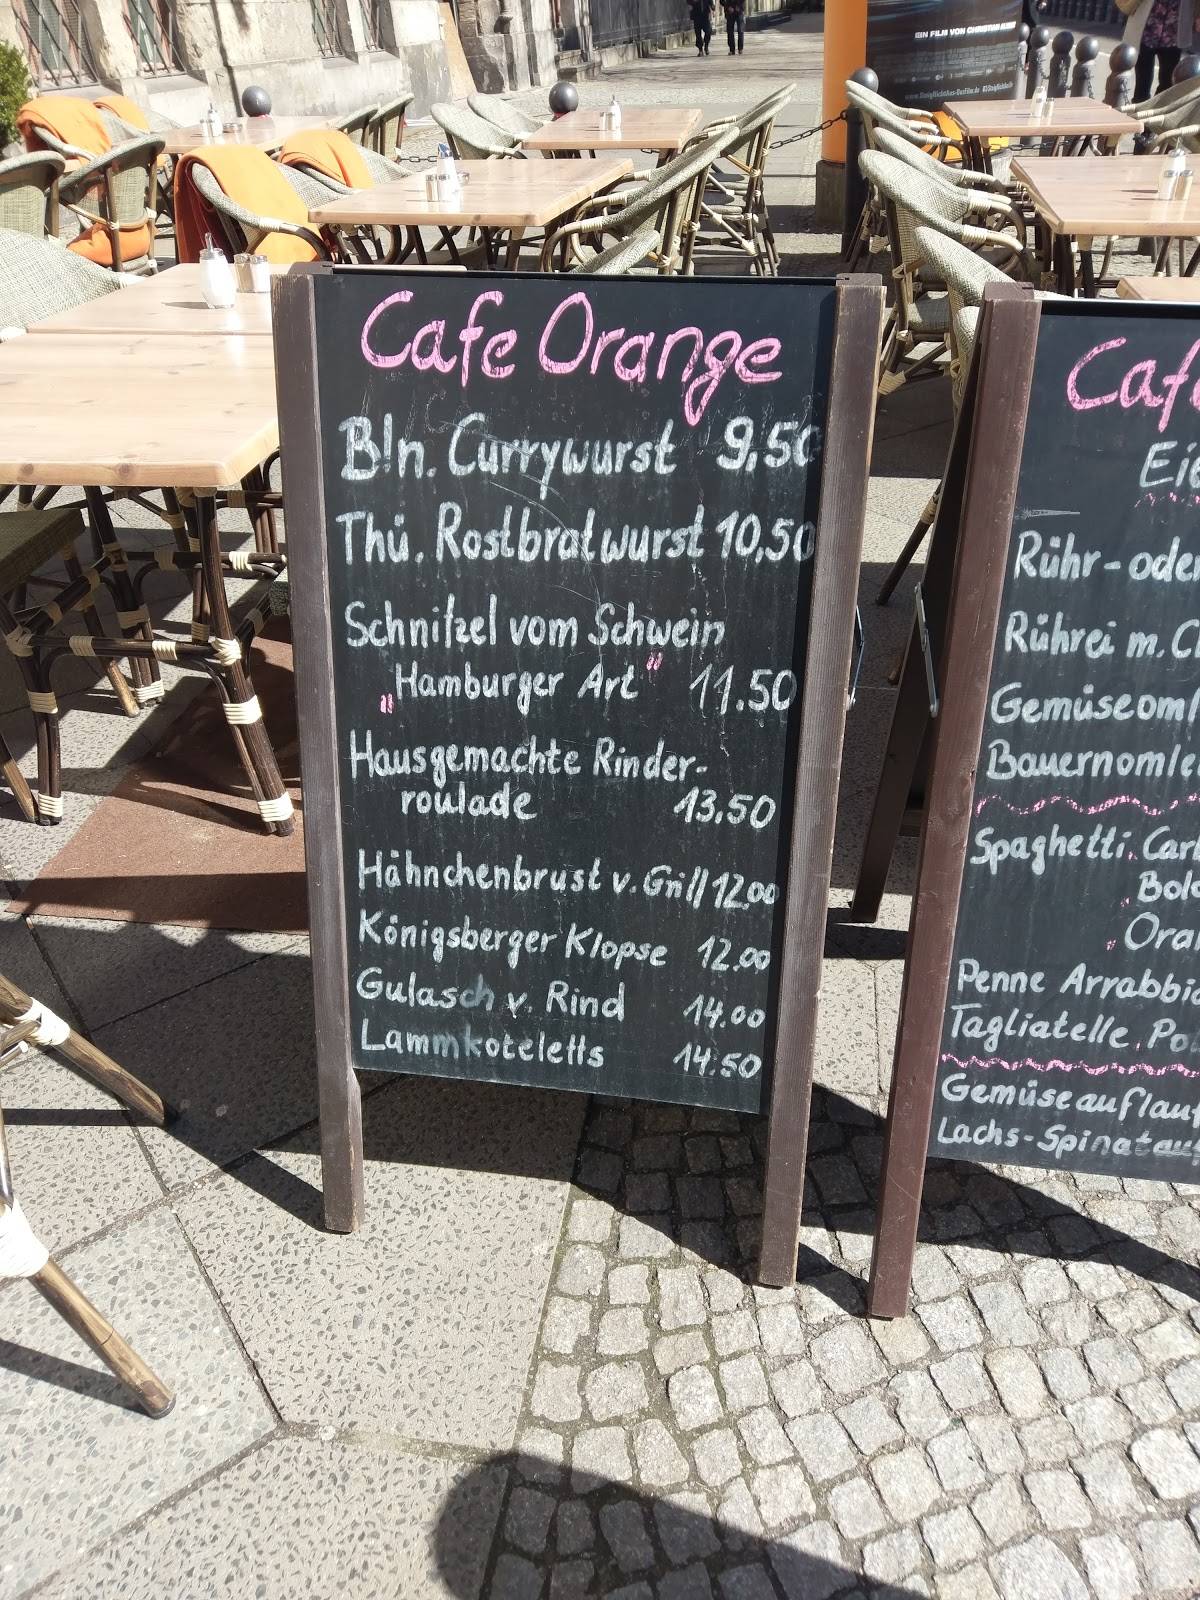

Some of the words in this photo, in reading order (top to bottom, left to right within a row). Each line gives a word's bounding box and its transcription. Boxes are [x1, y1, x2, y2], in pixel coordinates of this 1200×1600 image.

[930, 29, 948, 38] FILM
[950, 27, 966, 36] VON
[360, 290, 518, 388] Cafe
[537, 291, 784, 426] Orange
[338, 412, 438, 481] Bln.
[447, 411, 678, 500] Currywurst
[715, 415, 822, 472] 9,50
[436, 501, 705, 565] Rostbratwurst
[714, 508, 817, 564] 10,50
[345, 593, 498, 650] Schnitzel
[509, 613, 579, 647] vom
[587, 601, 726, 648] Schwein
[1004, 610, 1116, 660] Rührei
[1126, 632, 1165, 658] m.
[688, 662, 798, 715] 11.50
[350, 729, 582, 789] Hausgemachte
[592, 736, 708, 784] Rinder-
[986, 738, 1200, 780] Bauernomle
[400, 782, 538, 821] roulade
[357, 848, 602, 896] Hähnchenbrust
[969, 822, 1131, 876] Spaghetti
[358, 908, 558, 970] Königsberger
[565, 923, 668, 971] Klopse
[355, 966, 495, 1012] Gulasch
[545, 982, 625, 1022] Rind
[682, 994, 766, 1030] 14.00
[957, 958, 1046, 994] Penne
[360, 1018, 606, 1068] Lammkoteletts
[672, 1041, 762, 1080] 14.50
[950, 1003, 1130, 1053] Tagliatelle
